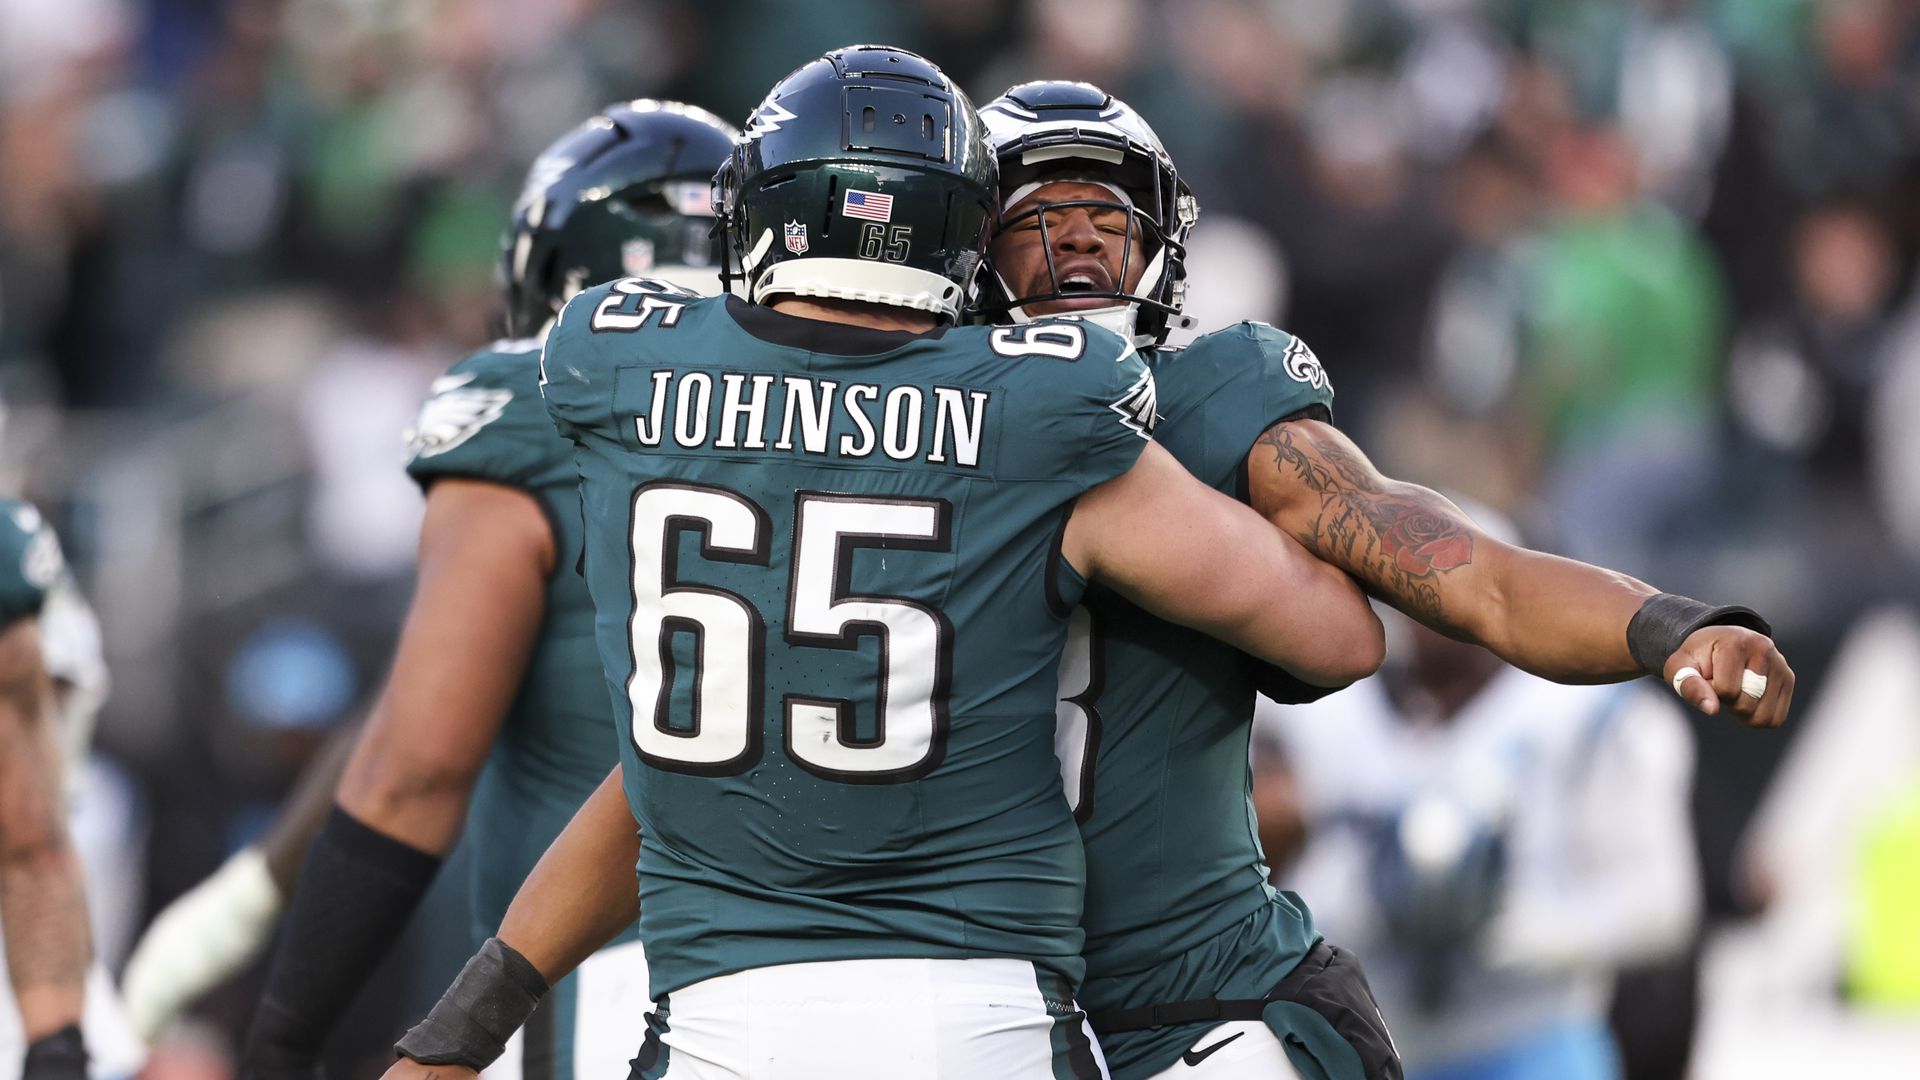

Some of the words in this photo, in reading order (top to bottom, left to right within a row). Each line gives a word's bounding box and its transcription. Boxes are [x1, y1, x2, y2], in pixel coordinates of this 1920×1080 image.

[788, 236, 806, 250] NFL
[860, 223, 911, 262] 65
[989, 316, 1087, 362] 6
[634, 370, 990, 468] JOHNSON
[627, 478, 954, 785] 65
